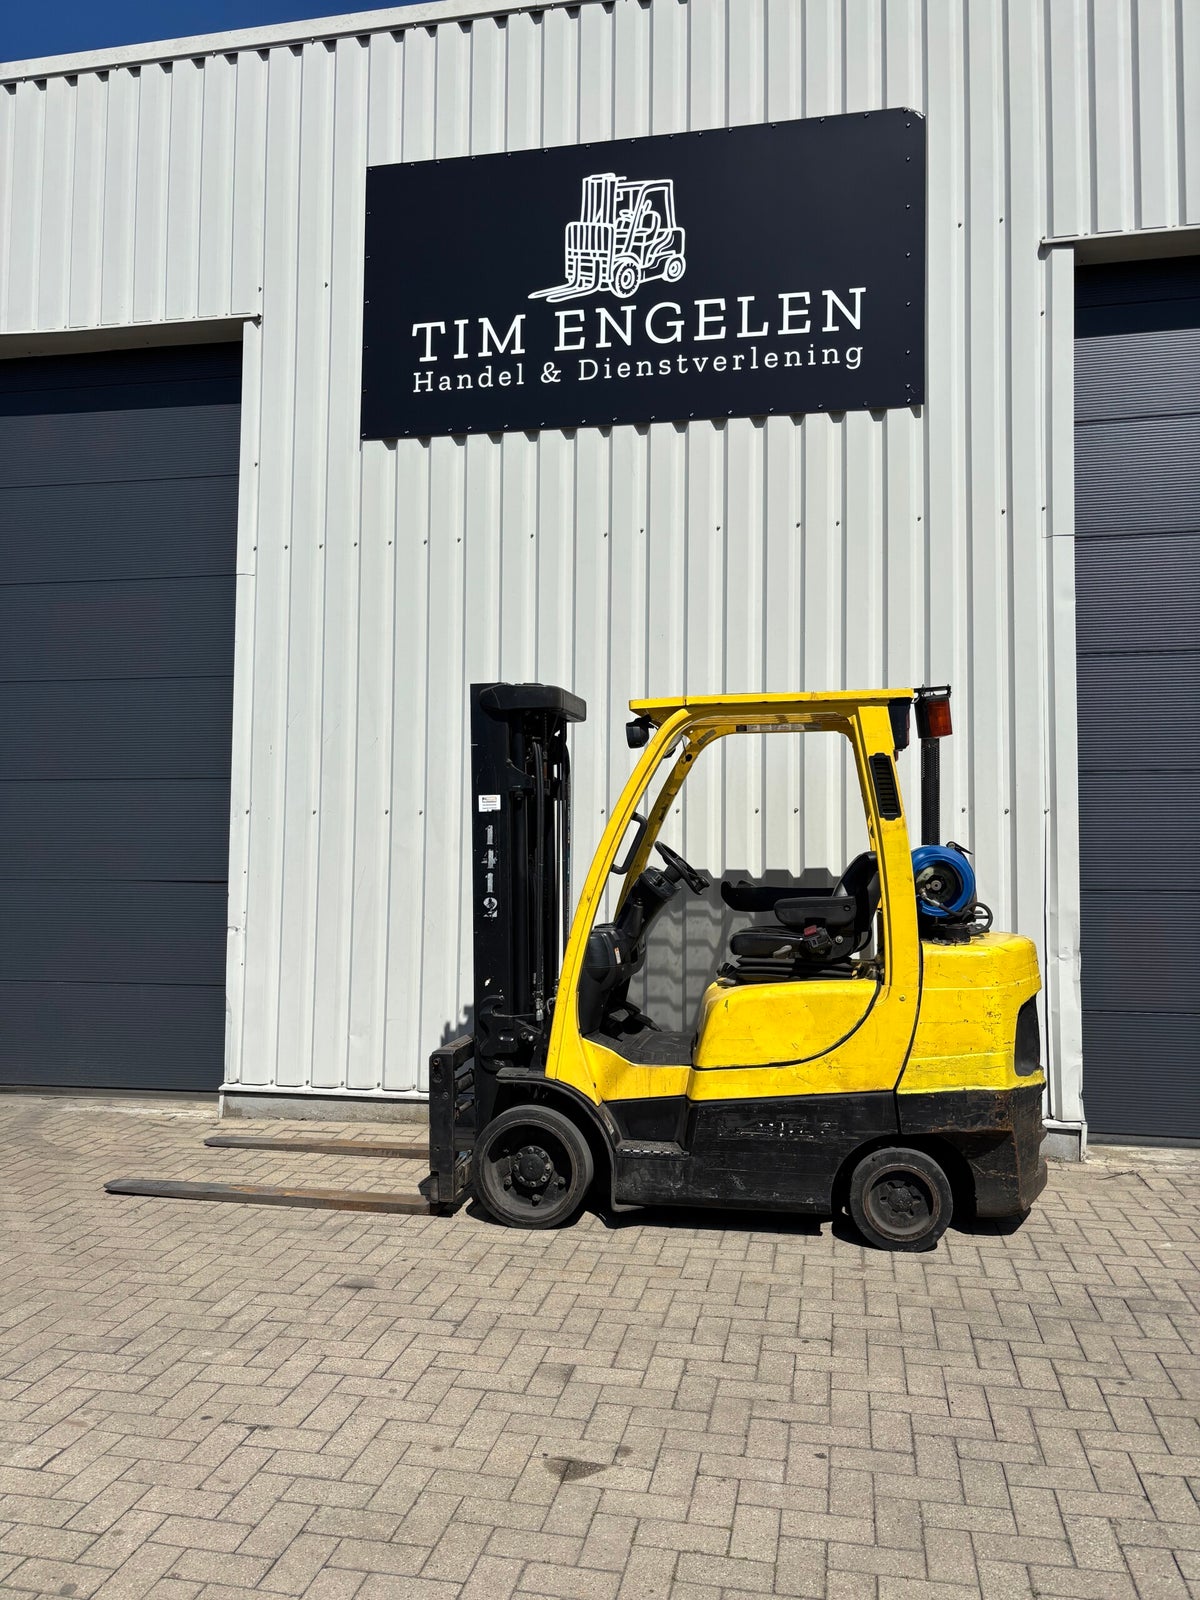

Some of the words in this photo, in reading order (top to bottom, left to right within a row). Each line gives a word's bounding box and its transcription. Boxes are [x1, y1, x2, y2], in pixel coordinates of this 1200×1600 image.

[412, 314, 526, 363] TIM
[554, 287, 867, 352] ENGELEN
[412, 363, 525, 393] Handel
[540, 361, 562, 384] &
[578, 344, 864, 381] Dienstverlening
